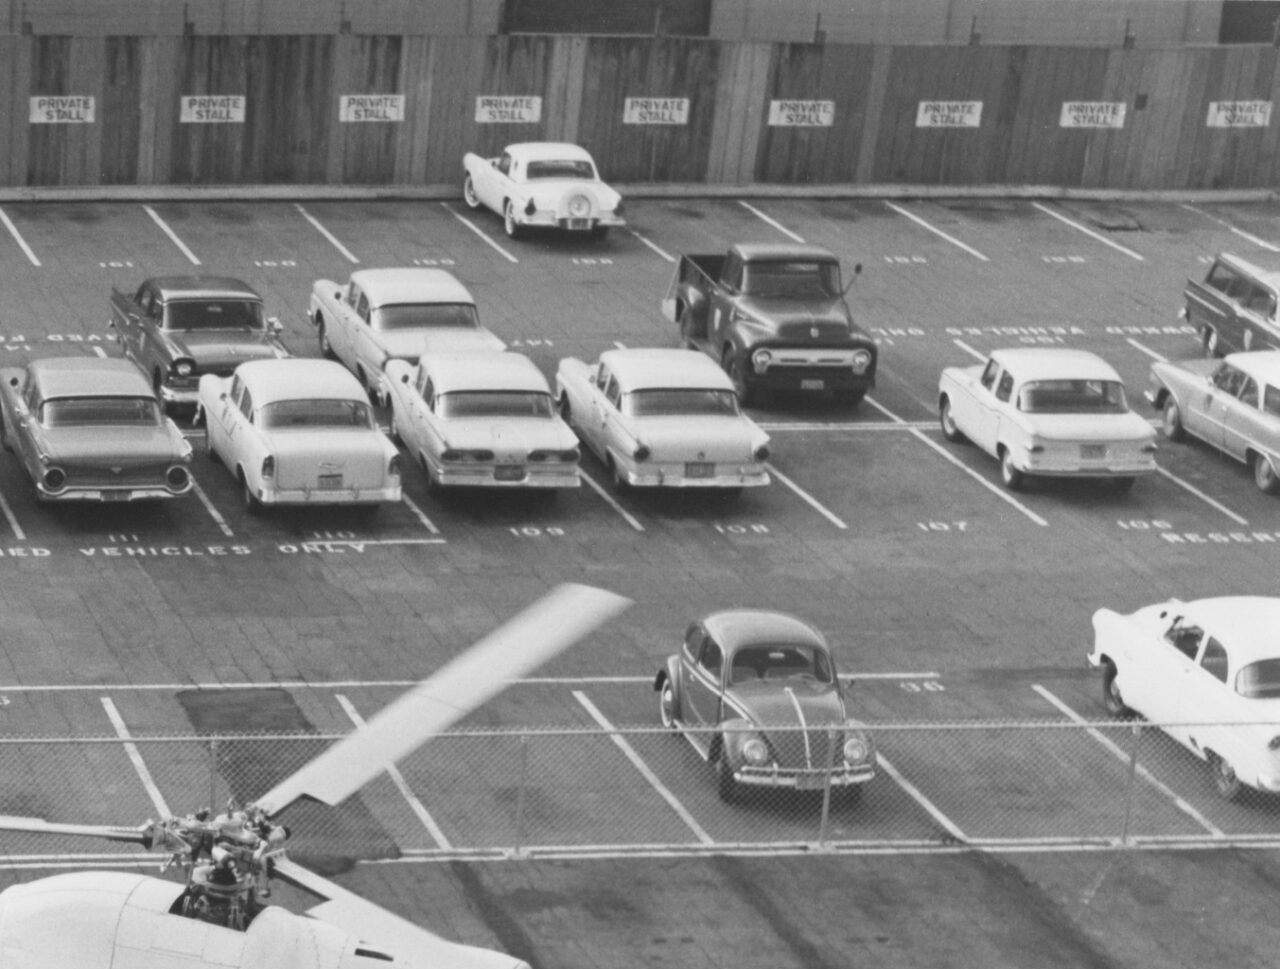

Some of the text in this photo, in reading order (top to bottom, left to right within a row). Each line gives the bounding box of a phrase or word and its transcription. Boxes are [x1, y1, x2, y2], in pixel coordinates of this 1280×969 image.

[38, 97, 90, 109] PRIVATE
[188, 97, 239, 109] PRIVATE
[347, 96, 397, 108] PRIVATE
[481, 97, 532, 109] PRIVATE
[630, 98, 683, 110] PRIVATE
[780, 102, 830, 113] PRIVATE
[354, 108, 391, 120] STALL
[924, 103, 974, 114] PRIVATE
[1068, 104, 1119, 115] PRIVATE
[1217, 103, 1267, 115] PRIVATE
[46, 109, 84, 121] STALL
[196, 109, 232, 120] STALL
[489, 109, 526, 121] STALL
[639, 110, 675, 121] STALL
[784, 113, 821, 124] STALL
[929, 114, 967, 125] STALL
[1072, 115, 1111, 126] STALL
[1223, 115, 1260, 126] STALL
[870, 327, 925, 336] ONL
[509, 526, 565, 537] 109
[917, 521, 968, 532] 107
[109, 534, 139, 543] 111
[314, 531, 356, 539] 110
[1161, 532, 1280, 543] RESER
[79, 545, 252, 556] VEHICLES
[277, 543, 367, 554] ONLY
